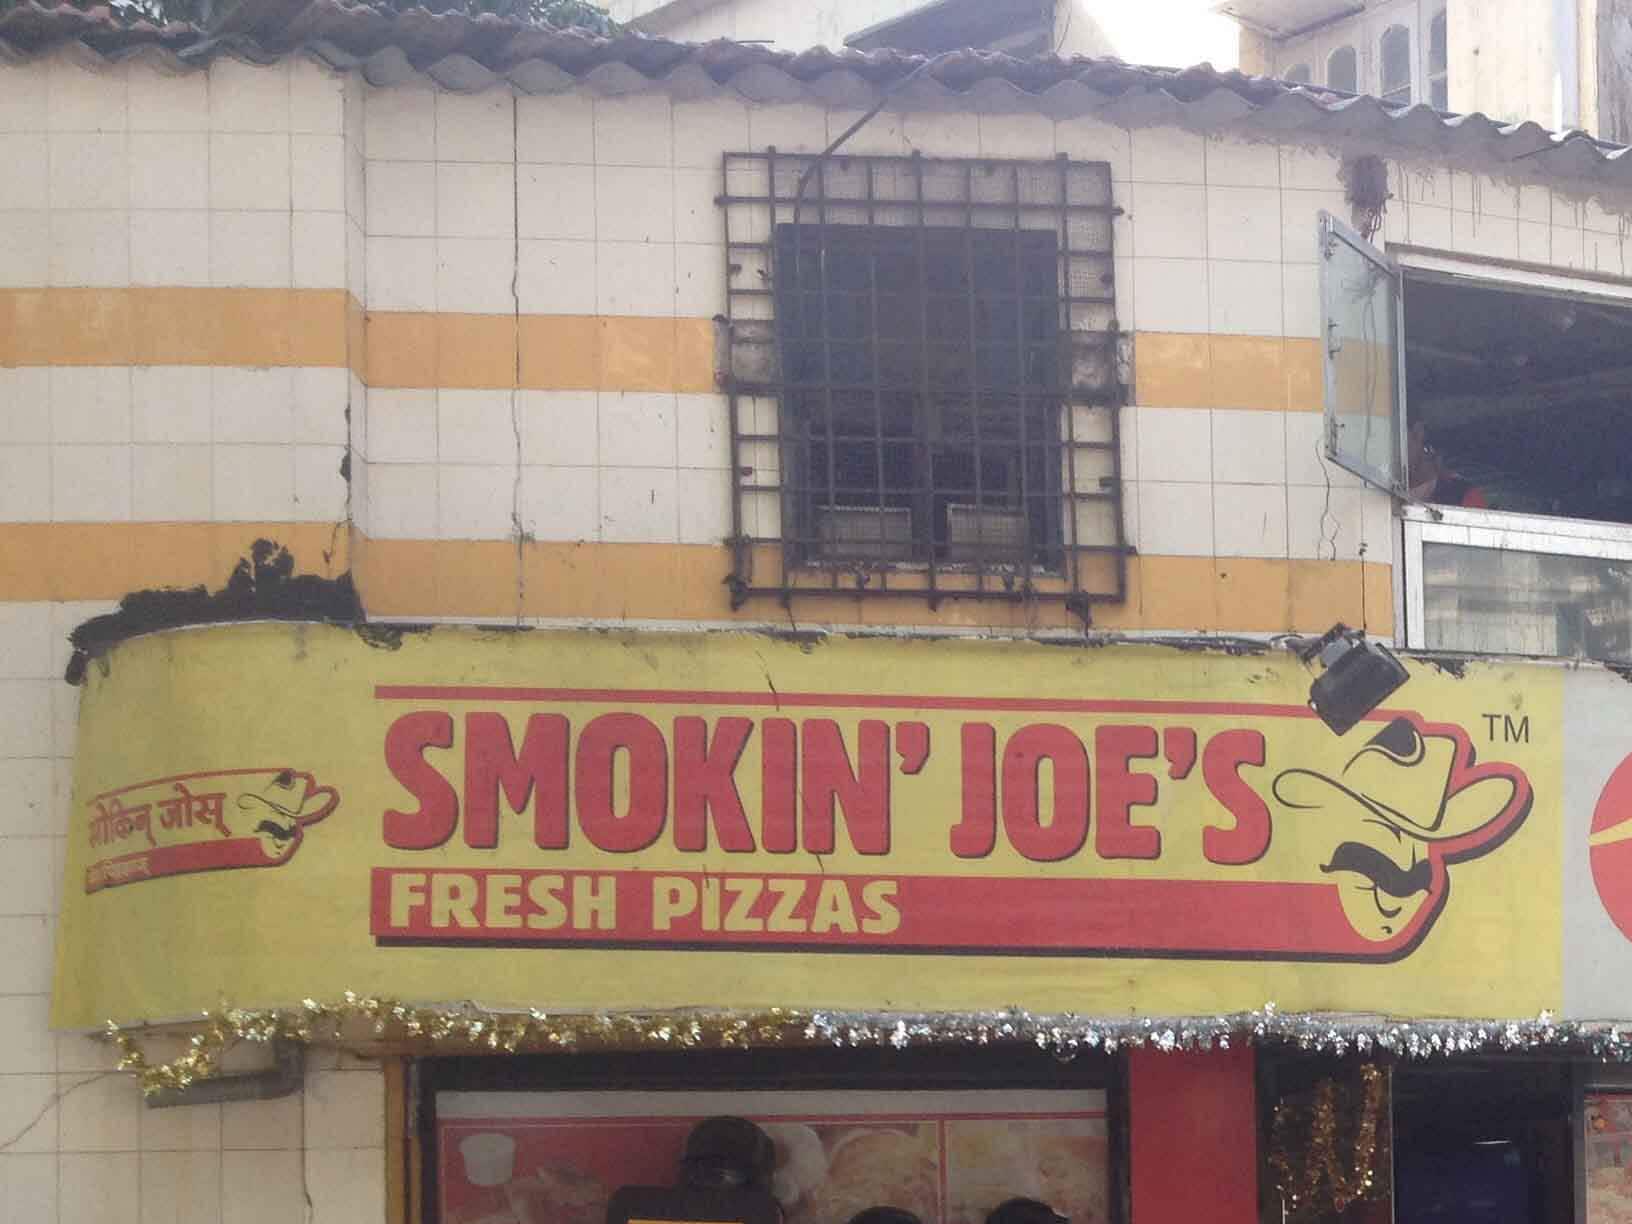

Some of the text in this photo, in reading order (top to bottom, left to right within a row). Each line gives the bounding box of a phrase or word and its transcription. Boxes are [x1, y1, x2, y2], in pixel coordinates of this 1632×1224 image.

[1481, 714, 1530, 743] TM
[382, 711, 1272, 866] SMOKIN' JOE'S
[390, 872, 901, 936] FRESH PIZZAS
